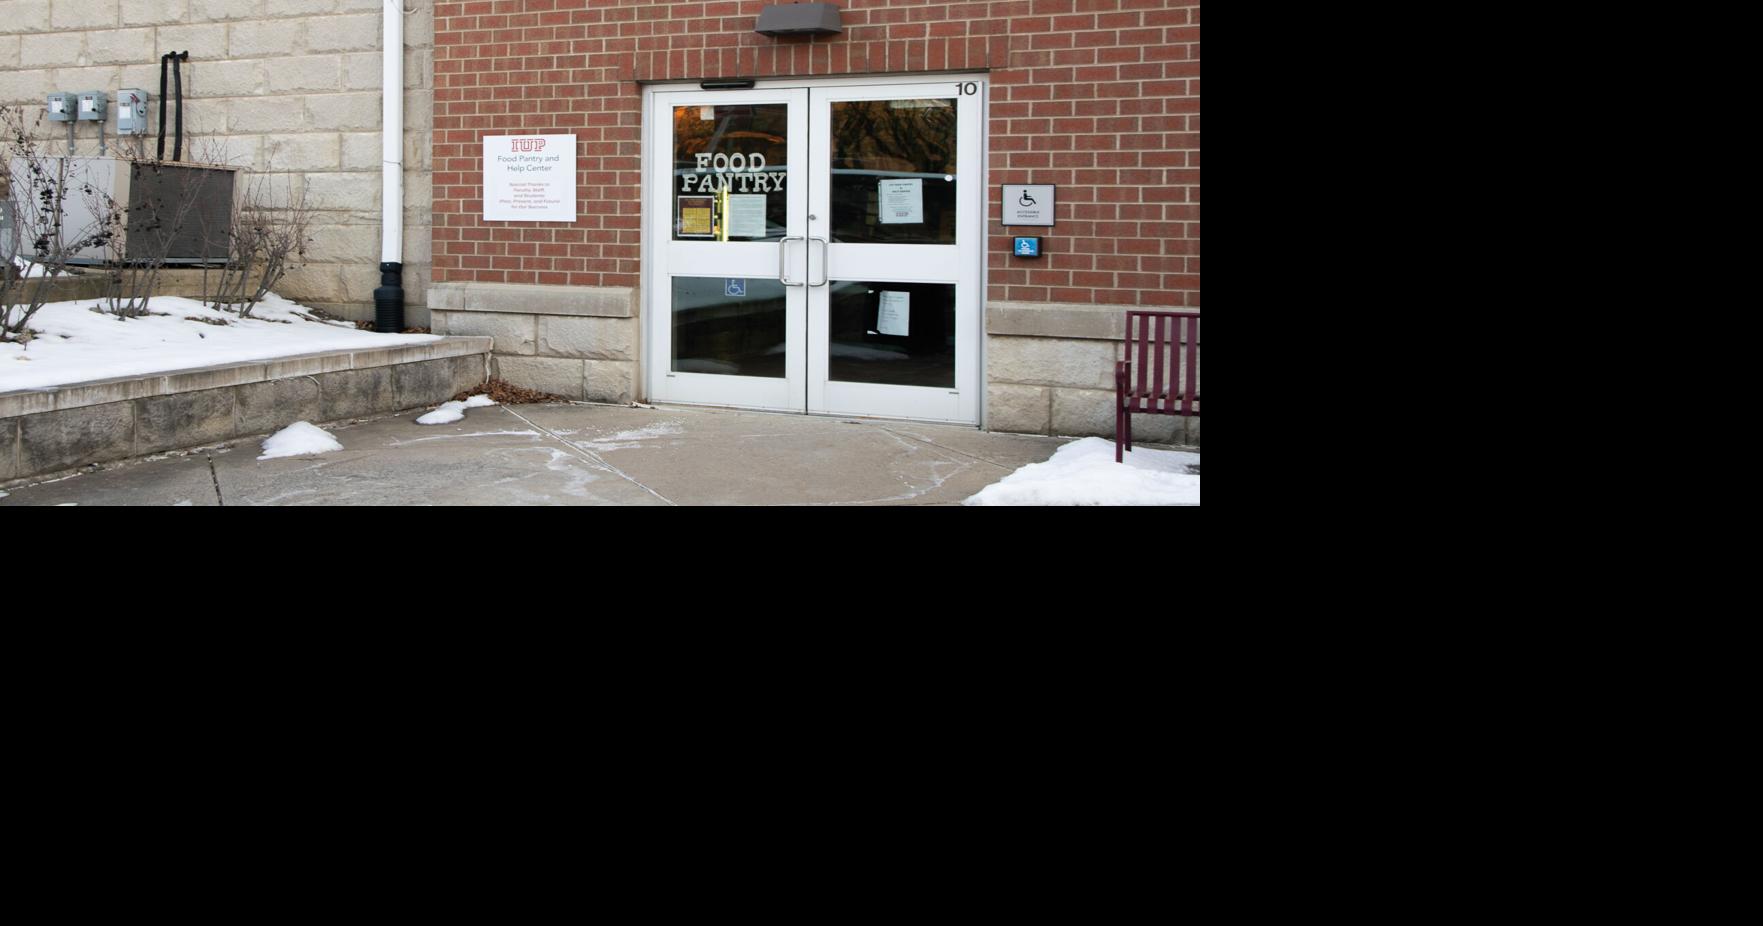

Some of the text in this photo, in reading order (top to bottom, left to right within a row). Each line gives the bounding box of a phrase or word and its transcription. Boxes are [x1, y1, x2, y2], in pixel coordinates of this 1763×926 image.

[955, 82, 977, 96] 10
[511, 138, 546, 152] IUP
[519, 154, 542, 163] Pantry
[544, 154, 560, 162] and
[694, 152, 766, 173] FOOD
[507, 164, 552, 173] Help Center
[681, 172, 787, 193] PANTRY
